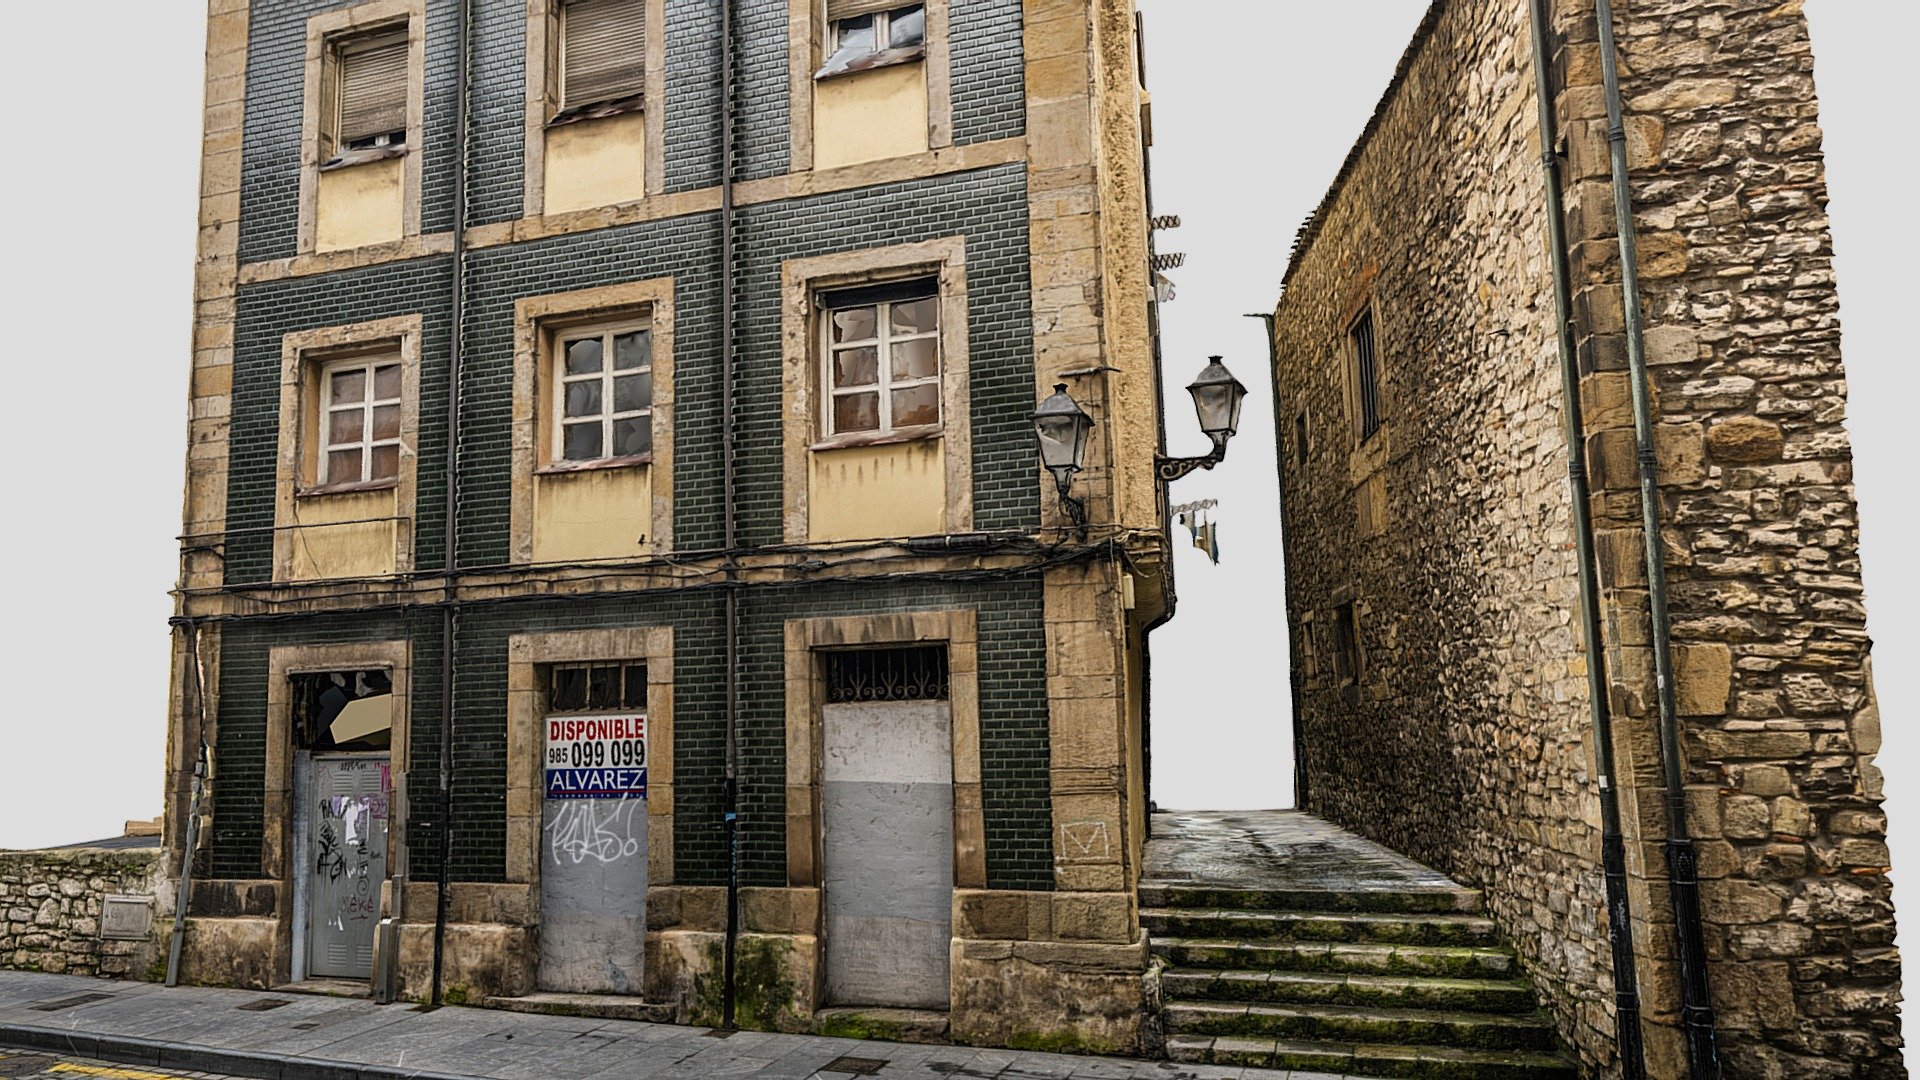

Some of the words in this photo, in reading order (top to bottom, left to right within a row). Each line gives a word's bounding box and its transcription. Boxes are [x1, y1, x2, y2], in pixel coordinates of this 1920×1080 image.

[550, 718, 644, 741] DISPONIBLE
[549, 747, 568, 764] 985
[571, 741, 605, 768] 099
[611, 739, 645, 767] 099
[550, 769, 645, 791] ALVAREZ
